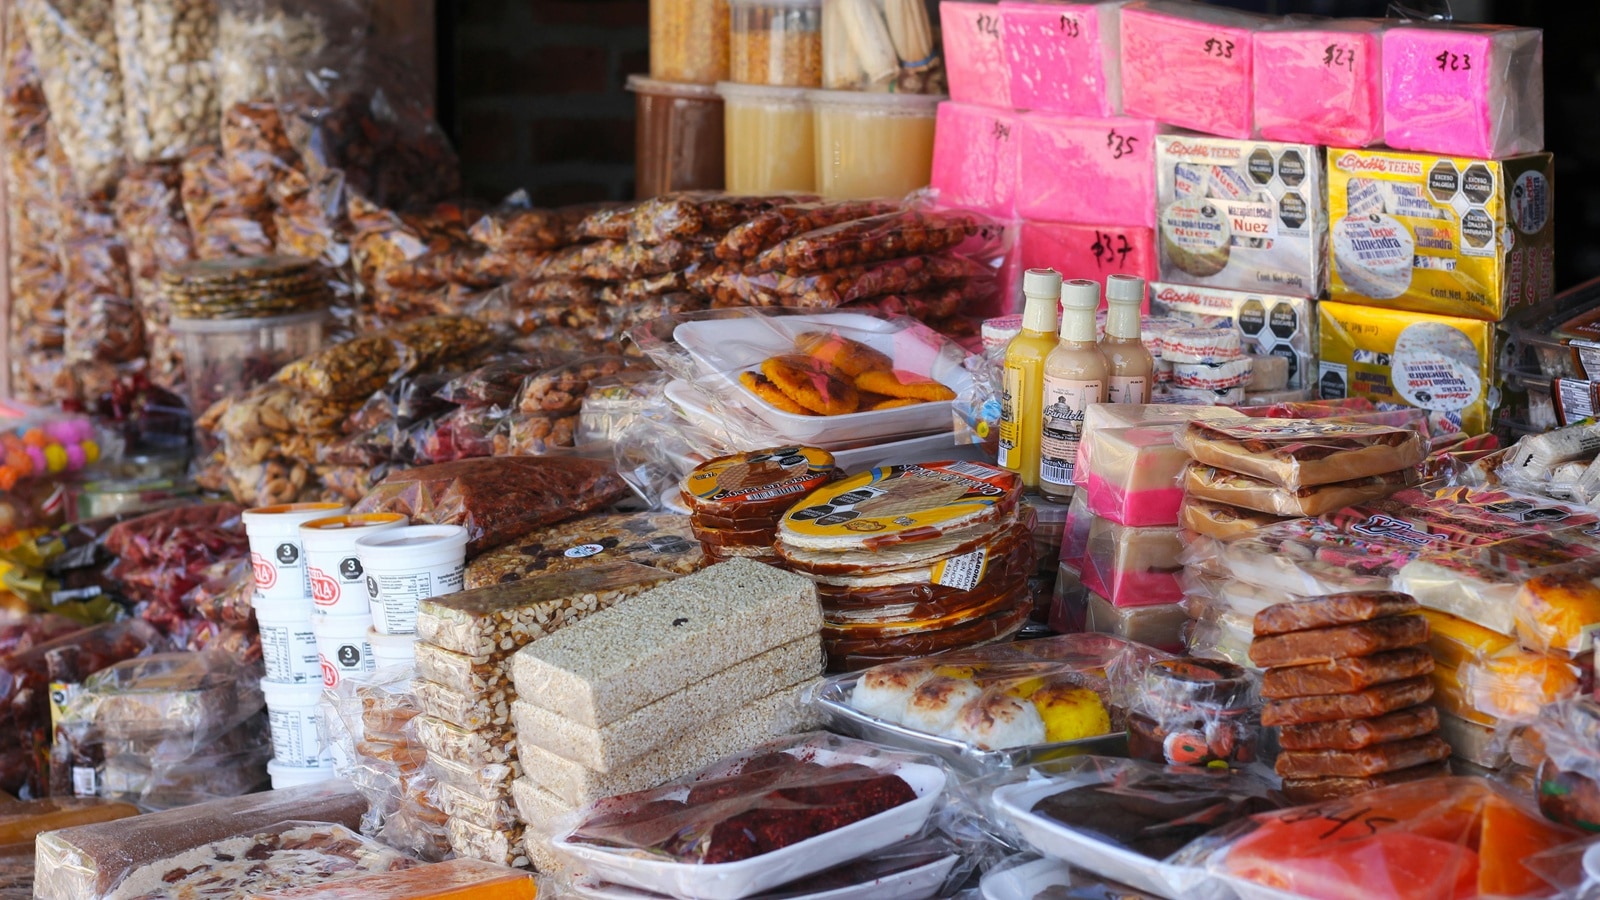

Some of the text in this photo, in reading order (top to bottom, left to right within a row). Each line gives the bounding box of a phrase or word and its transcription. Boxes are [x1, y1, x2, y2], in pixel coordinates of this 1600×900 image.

[1203, 38, 1235, 58] $33
[1323, 44, 1355, 72] $27
[1436, 51, 1472, 71] $23
[1106, 129, 1139, 159] $35
[1211, 147, 1241, 159] TEENS
[1388, 161, 1420, 174] TEENS
[1211, 165, 1239, 197] Nuez
[1468, 176, 1488, 184] EXCESO
[1234, 219, 1269, 233] Nuez
[1174, 228, 1210, 238] Nuez
[1090, 230, 1133, 270] $37
[1351, 238, 1401, 251] Almendra
[1510, 252, 1522, 306] TEENS
[1202, 296, 1232, 308] TEENS
[1409, 372, 1453, 380] Almendra
[283, 545, 292, 556] 3
[348, 560, 356, 570] 3
[344, 648, 352, 658] 3
